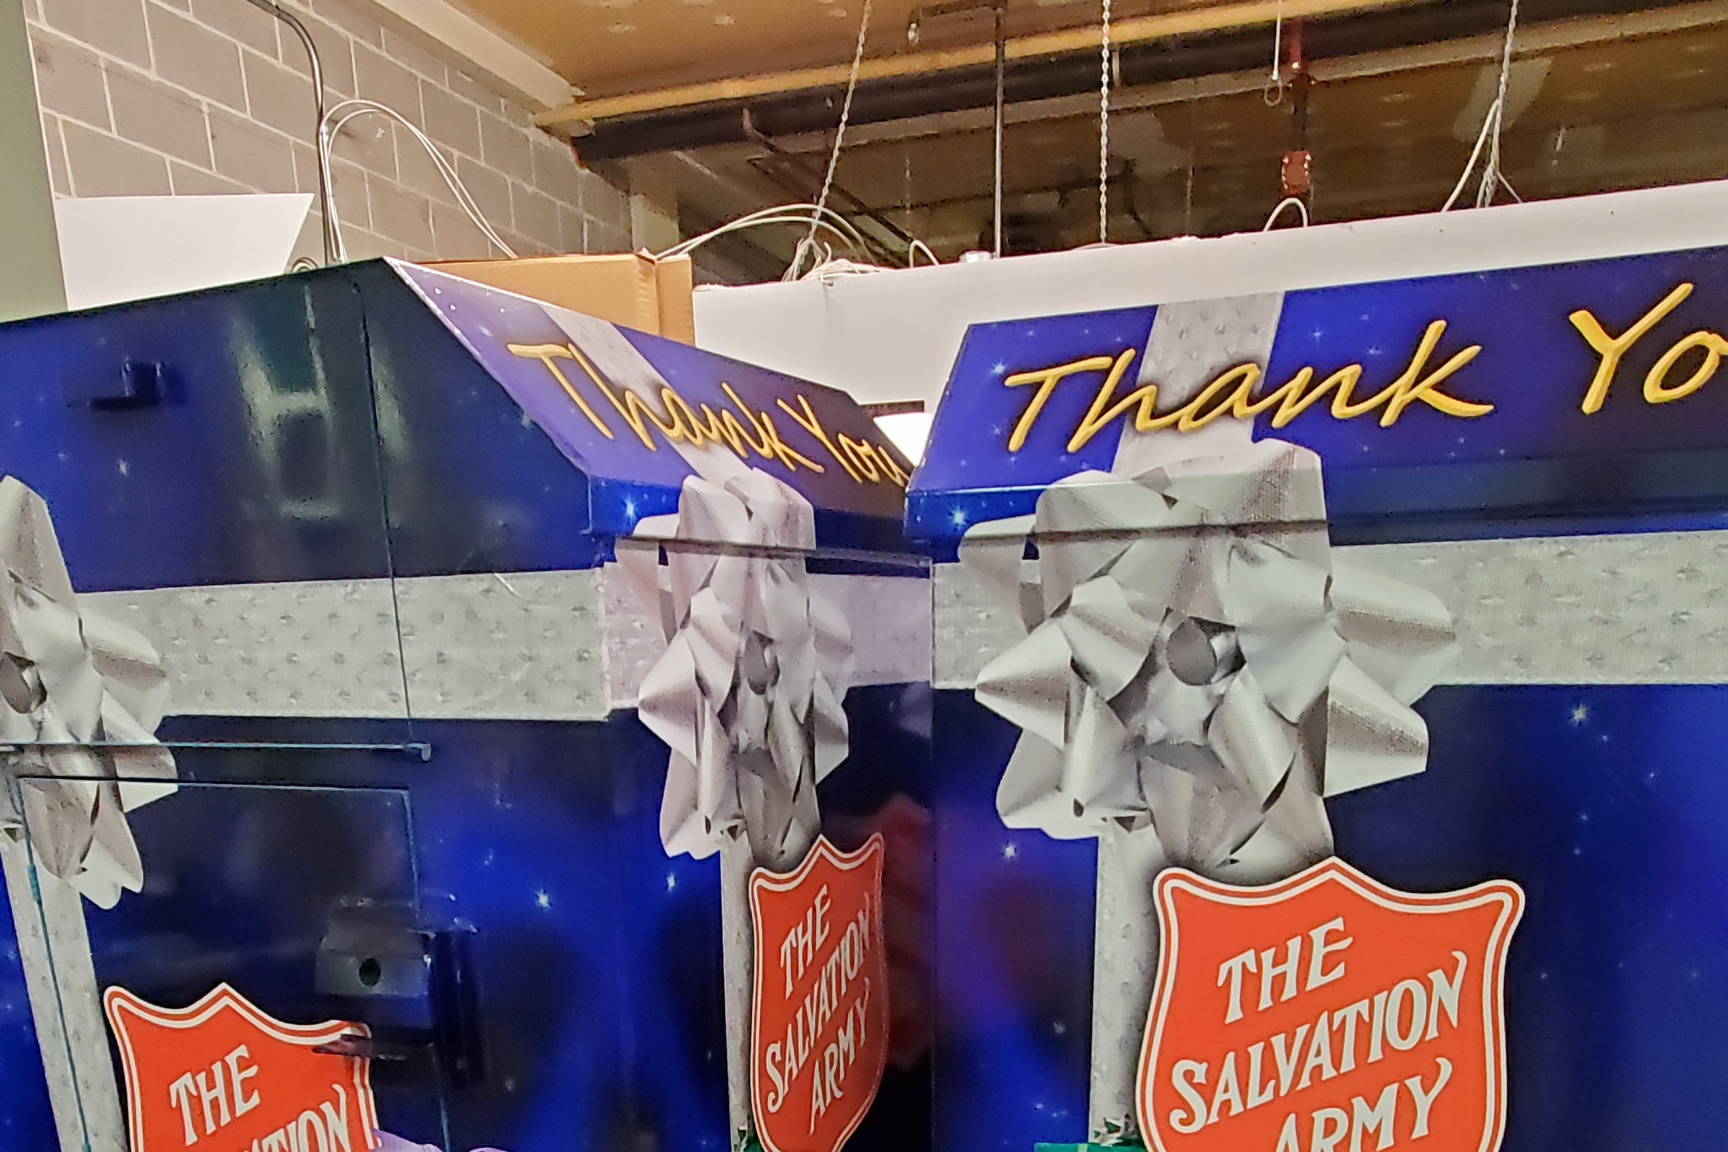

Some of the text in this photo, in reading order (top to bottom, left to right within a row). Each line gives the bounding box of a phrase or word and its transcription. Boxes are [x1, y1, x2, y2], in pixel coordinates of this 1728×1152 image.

[505, 341, 911, 488] Thank You
[1004, 282, 1728, 454] Thank Yo
[764, 890, 872, 1114] SALVATION
[780, 883, 832, 1001] THE
[1216, 915, 1354, 1025] THE
[169, 1043, 261, 1147] THE
[808, 975, 871, 1137] ARMY
[1168, 949, 1468, 1135] SALVATION
